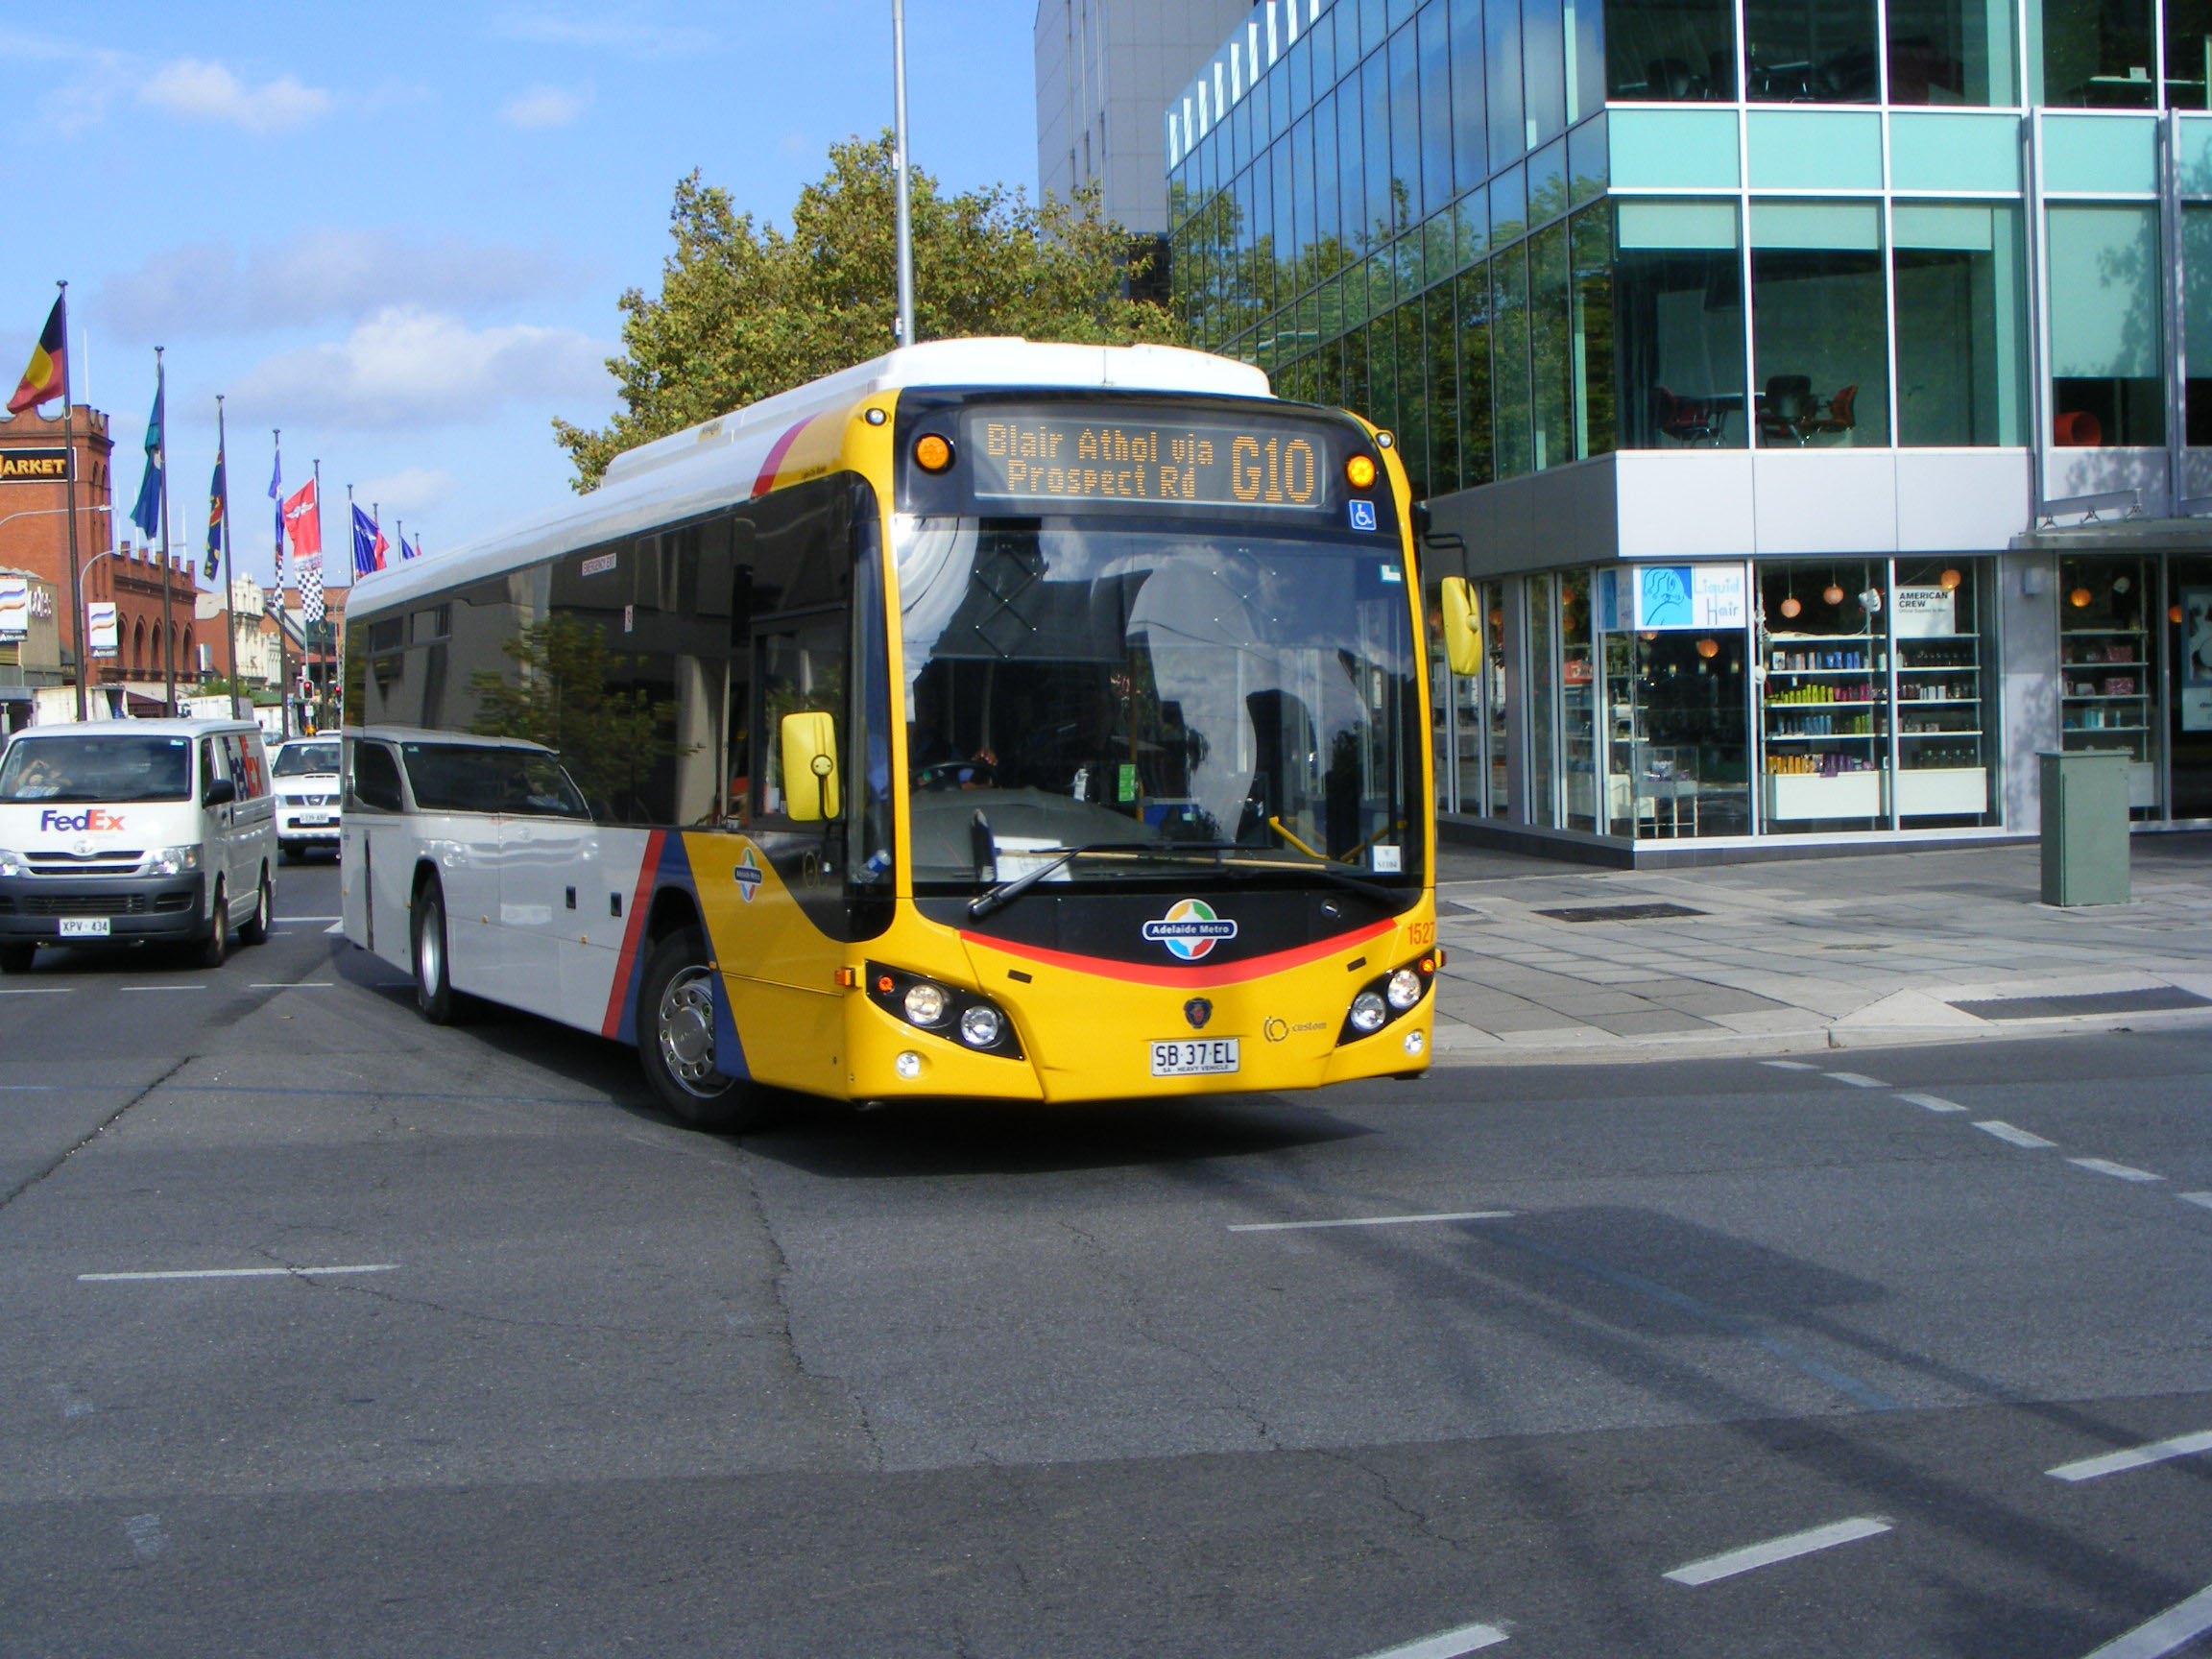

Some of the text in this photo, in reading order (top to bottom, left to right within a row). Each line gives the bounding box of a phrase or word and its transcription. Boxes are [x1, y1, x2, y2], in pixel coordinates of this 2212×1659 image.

[987, 423, 1214, 465] Blair Athol via
[1007, 459, 1195, 497] Prospect Rd
[1232, 435, 1314, 502] G10
[1693, 566, 1740, 599] Liquid
[1899, 591, 1949, 600] AMERICAN
[1706, 597, 1741, 626] Hair
[40, 808, 127, 832] FedEx
[62, 921, 108, 931] XPV 434
[1151, 925, 1230, 934] Adelaide Metro
[1407, 921, 1435, 946] 1527
